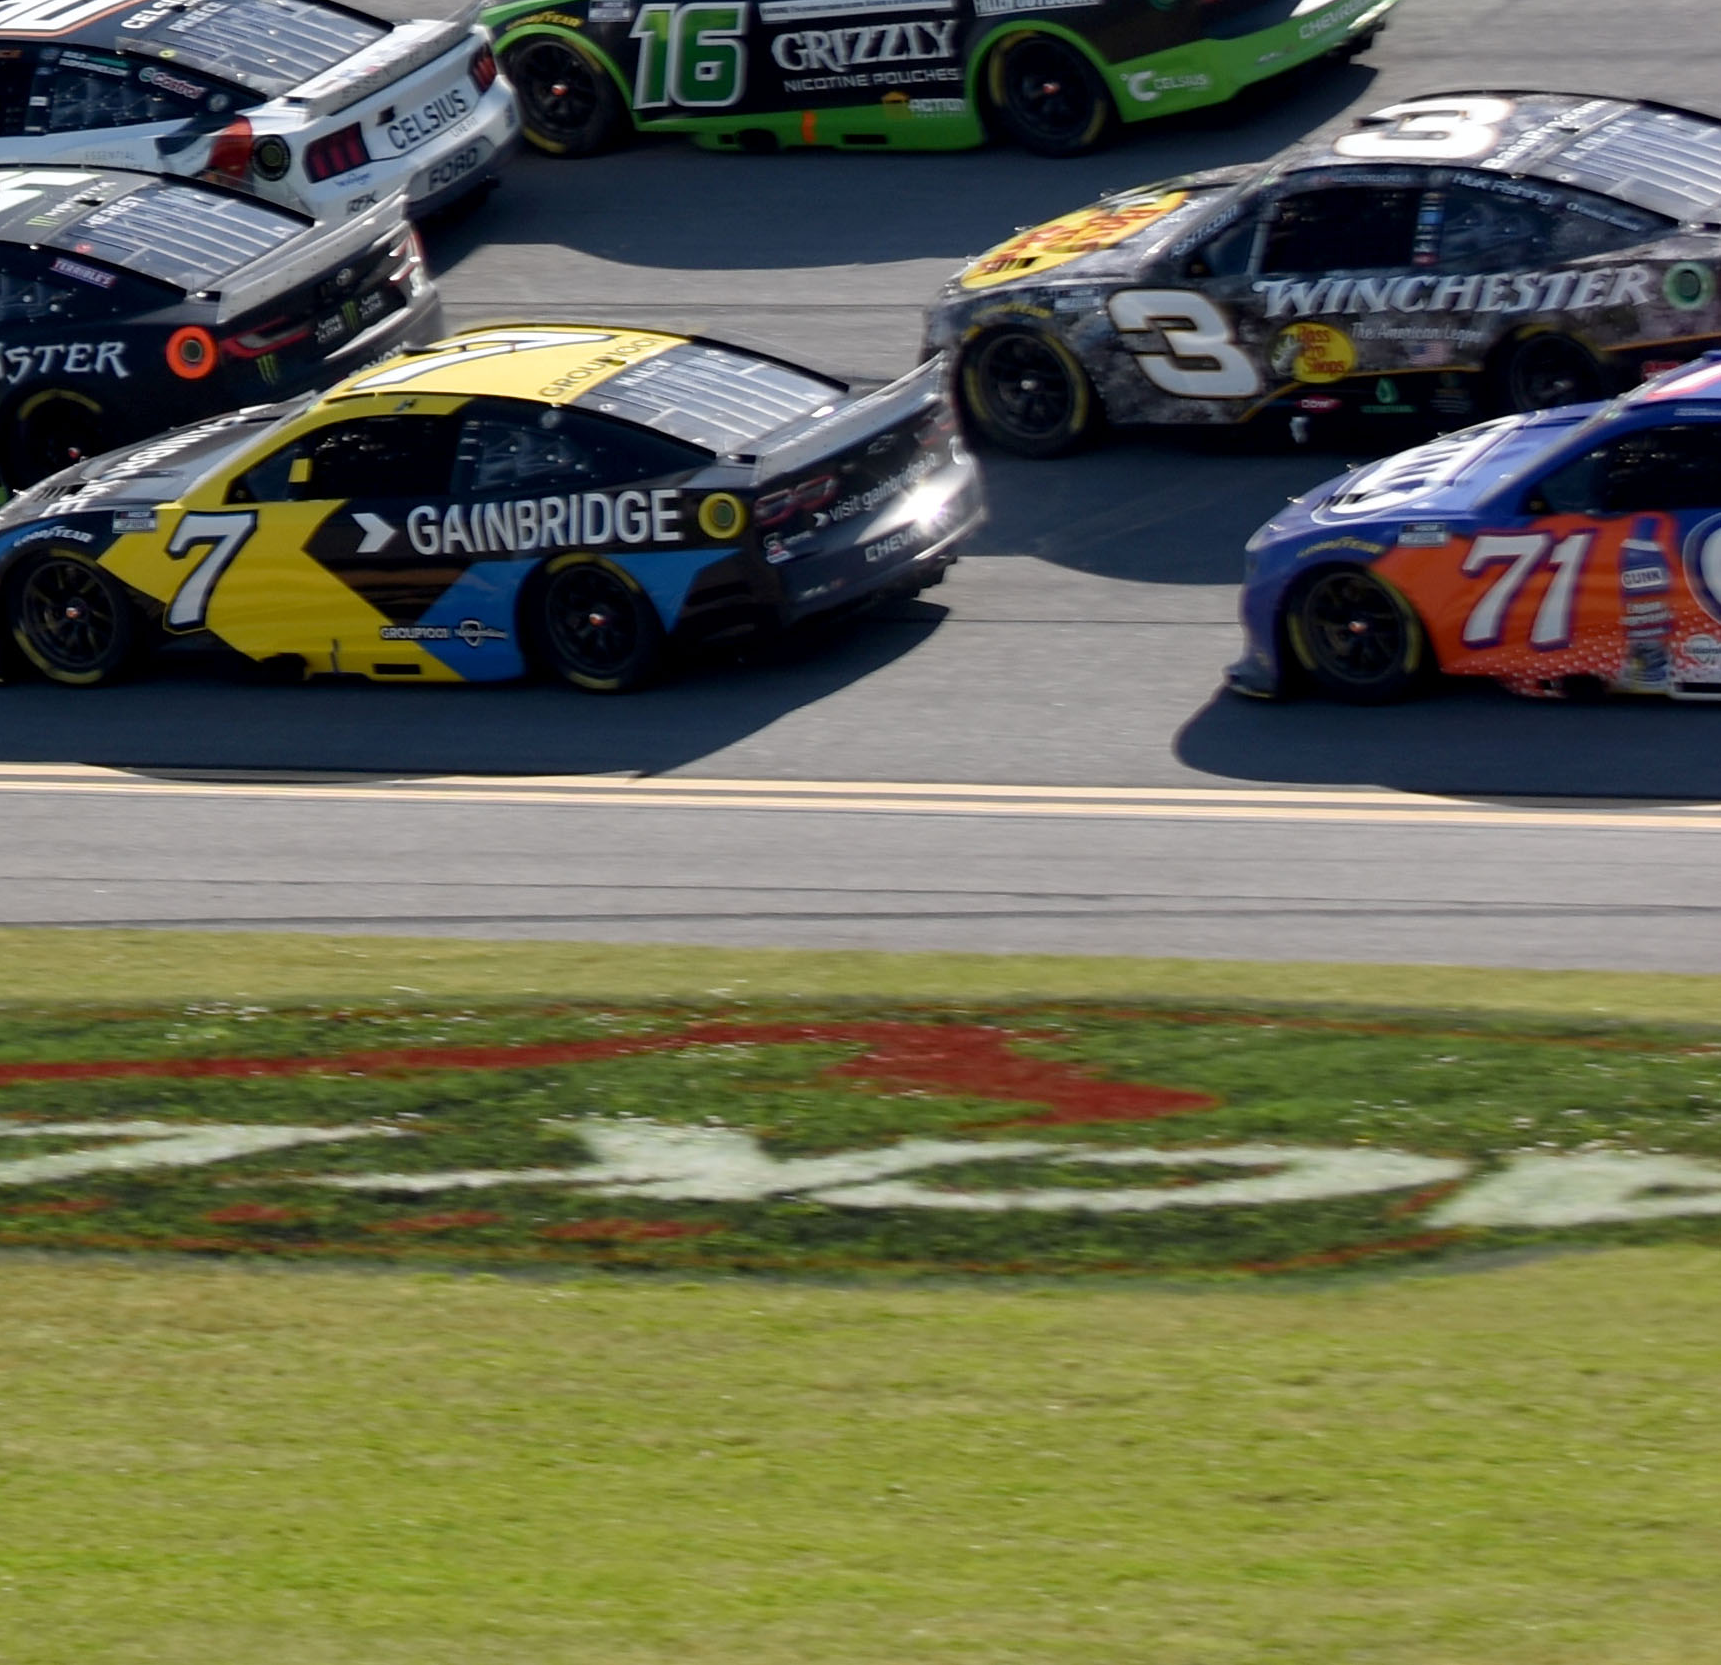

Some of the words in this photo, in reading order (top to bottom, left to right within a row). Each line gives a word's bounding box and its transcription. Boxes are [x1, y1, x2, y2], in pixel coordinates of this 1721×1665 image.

[629, 1, 749, 110] 16
[771, 19, 959, 73] GRIZZLY
[784, 74, 869, 92] NICOTINE
[873, 68, 962, 85] POUCHES
[386, 88, 469, 151] CELSIUS
[428, 147, 479, 188] FORD
[1490, 180, 1554, 206] Fishing
[1253, 264, 1654, 318] WINCHESTER
[1107, 290, 1262, 399] 3
[1297, 325, 1330, 345] Bass
[1300, 345, 1325, 360] Pro
[1304, 358, 1345, 377] Shops
[406, 488, 683, 556] GAINBRIDGE
[829, 500, 861, 522] visit
[13, 525, 94, 547] GOODYEAR
[163, 510, 258, 633] 7
[1462, 530, 1598, 650] 71
